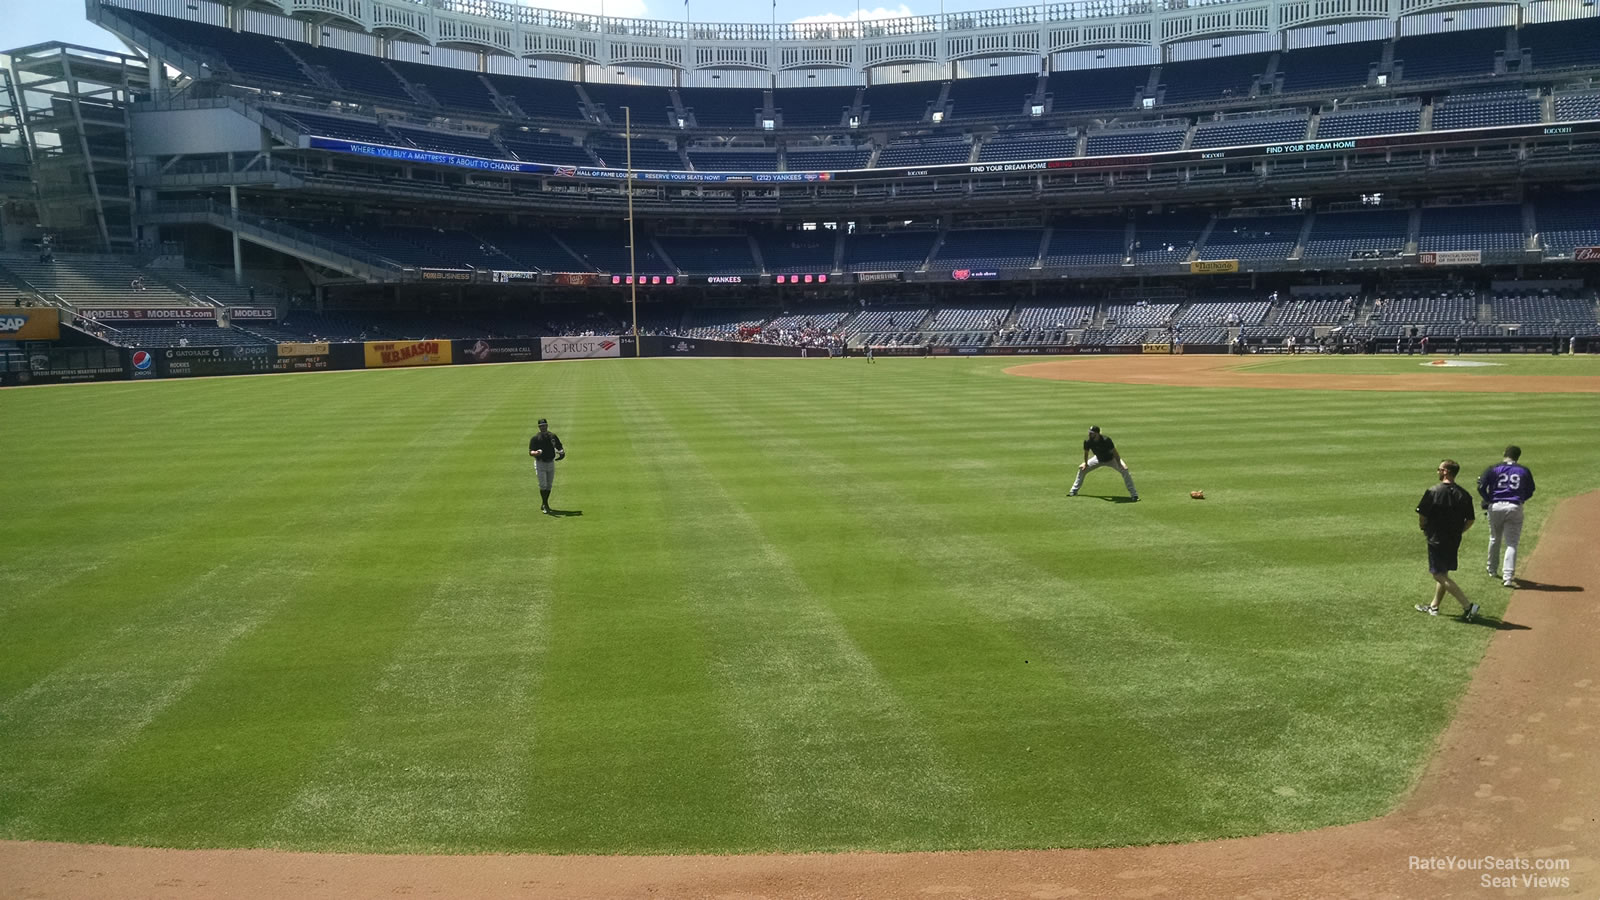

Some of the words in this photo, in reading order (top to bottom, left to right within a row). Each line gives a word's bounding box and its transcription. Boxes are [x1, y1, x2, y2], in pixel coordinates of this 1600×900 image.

[1305, 143, 1332, 151] DREAM
[350, 145, 375, 154] WHERE
[377, 148, 392, 156] YOU
[393, 150, 407, 158] BUY
[414, 153, 446, 162] MATTRESS
[456, 158, 479, 166] ABOUT
[490, 163, 520, 171] CHANGE
[1004, 163, 1027, 171] DREAM
[757, 174, 771, 182] (212)
[1420, 254, 1435, 264] JBL
[83, 310, 129, 320] MODELL'S
[147, 310, 212, 319] MODELLS.com
[234, 310, 272, 318] MODELL'S
[245, 347, 268, 355] pepsi
[400, 342, 438, 360] MASON
[544, 344, 561, 353] U.S.
[563, 343, 594, 353] TRUST
[1497, 473, 1521, 489] 29
